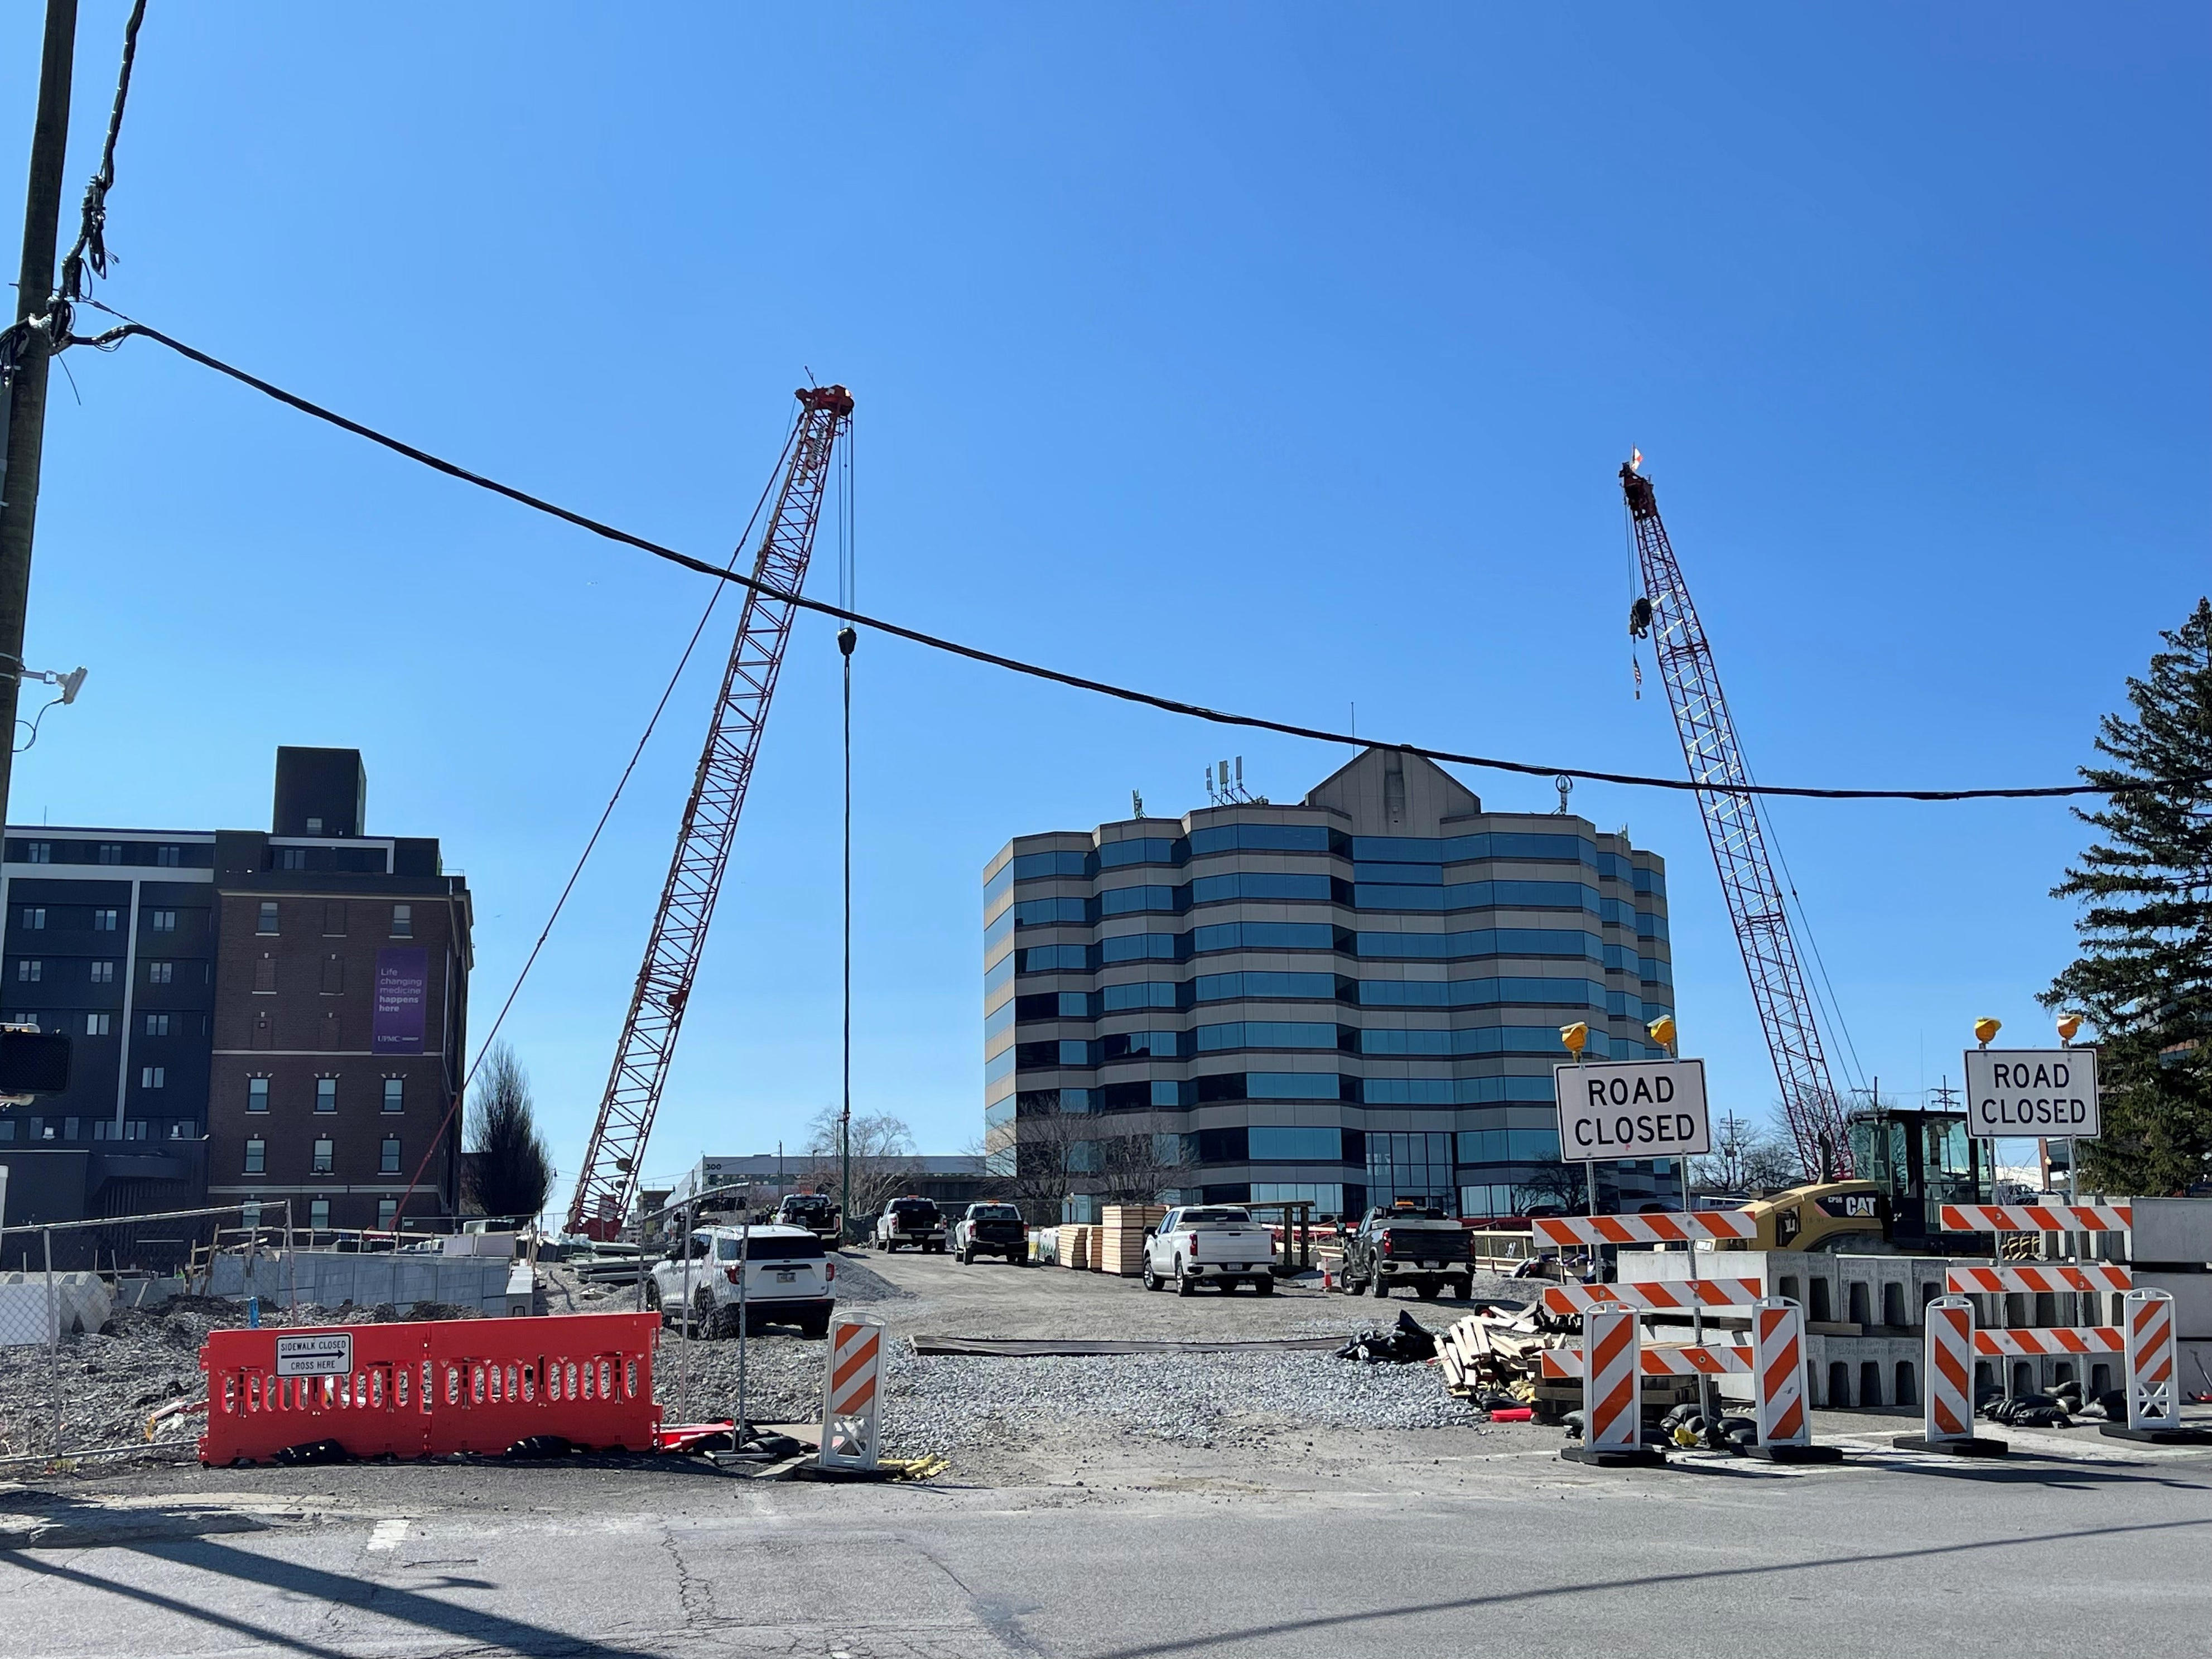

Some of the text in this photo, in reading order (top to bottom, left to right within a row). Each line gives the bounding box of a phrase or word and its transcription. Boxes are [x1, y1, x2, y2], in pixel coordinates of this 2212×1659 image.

[380, 977, 422, 986] changing
[379, 995, 419, 1004] happens
[1993, 1063, 2070, 1088] ROAD
[1588, 1076, 1674, 1106] ROAD
[1982, 1099, 2086, 1124] CLOSED
[1575, 1113, 1695, 1146] CLOSED
[1845, 1197, 1876, 1217] CAT
[281, 1340, 346, 1351] SIDEWALK CLOSED
[291, 1361, 335, 1370] CROSS HERE
